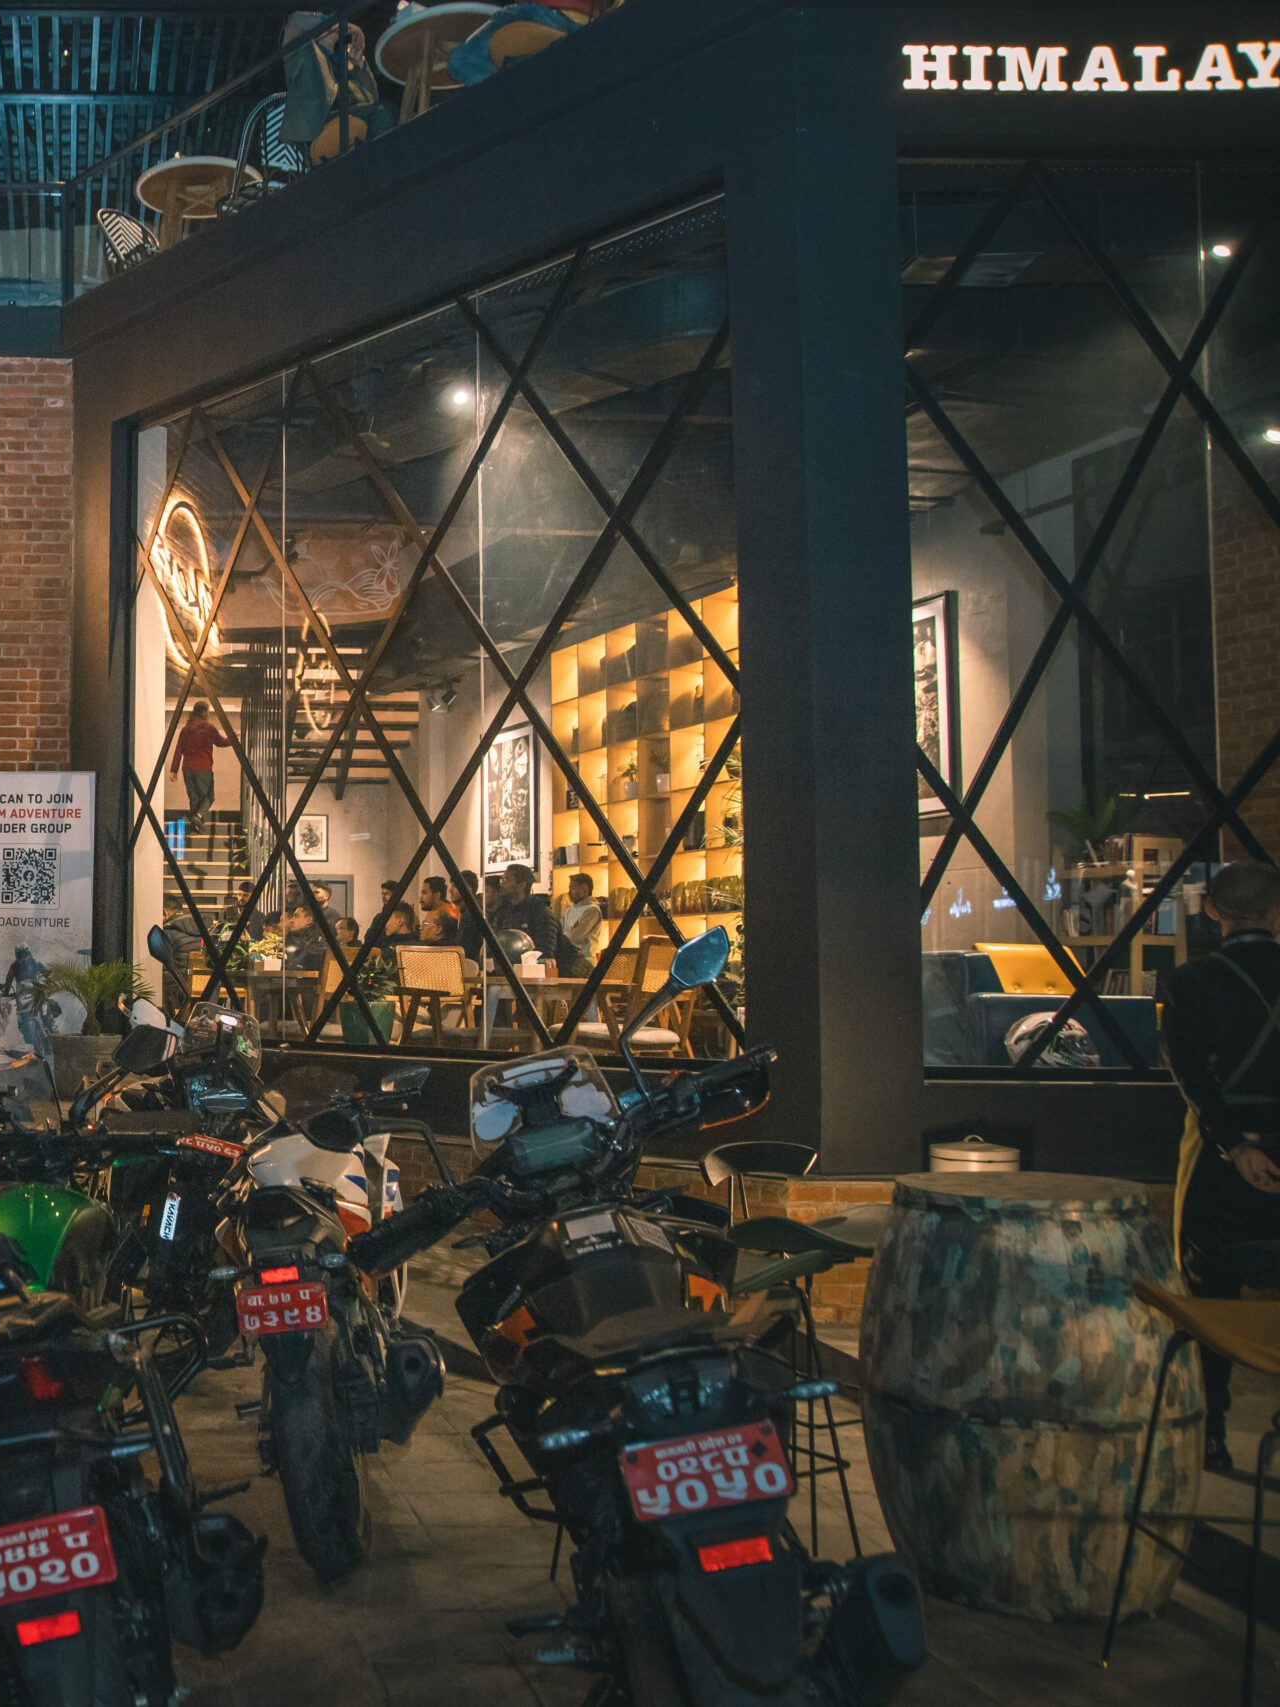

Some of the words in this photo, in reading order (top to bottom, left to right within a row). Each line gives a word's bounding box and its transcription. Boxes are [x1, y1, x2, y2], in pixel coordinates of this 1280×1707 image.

[27, 794, 43, 803] TO
[47, 793, 73, 804] JOIN
[10, 808, 81, 819] ADVENTURE
[30, 823, 72, 833] GROUP
[163, 1203, 176, 1239] KAVACH
[636, 1462, 787, 1515] ५०५०
